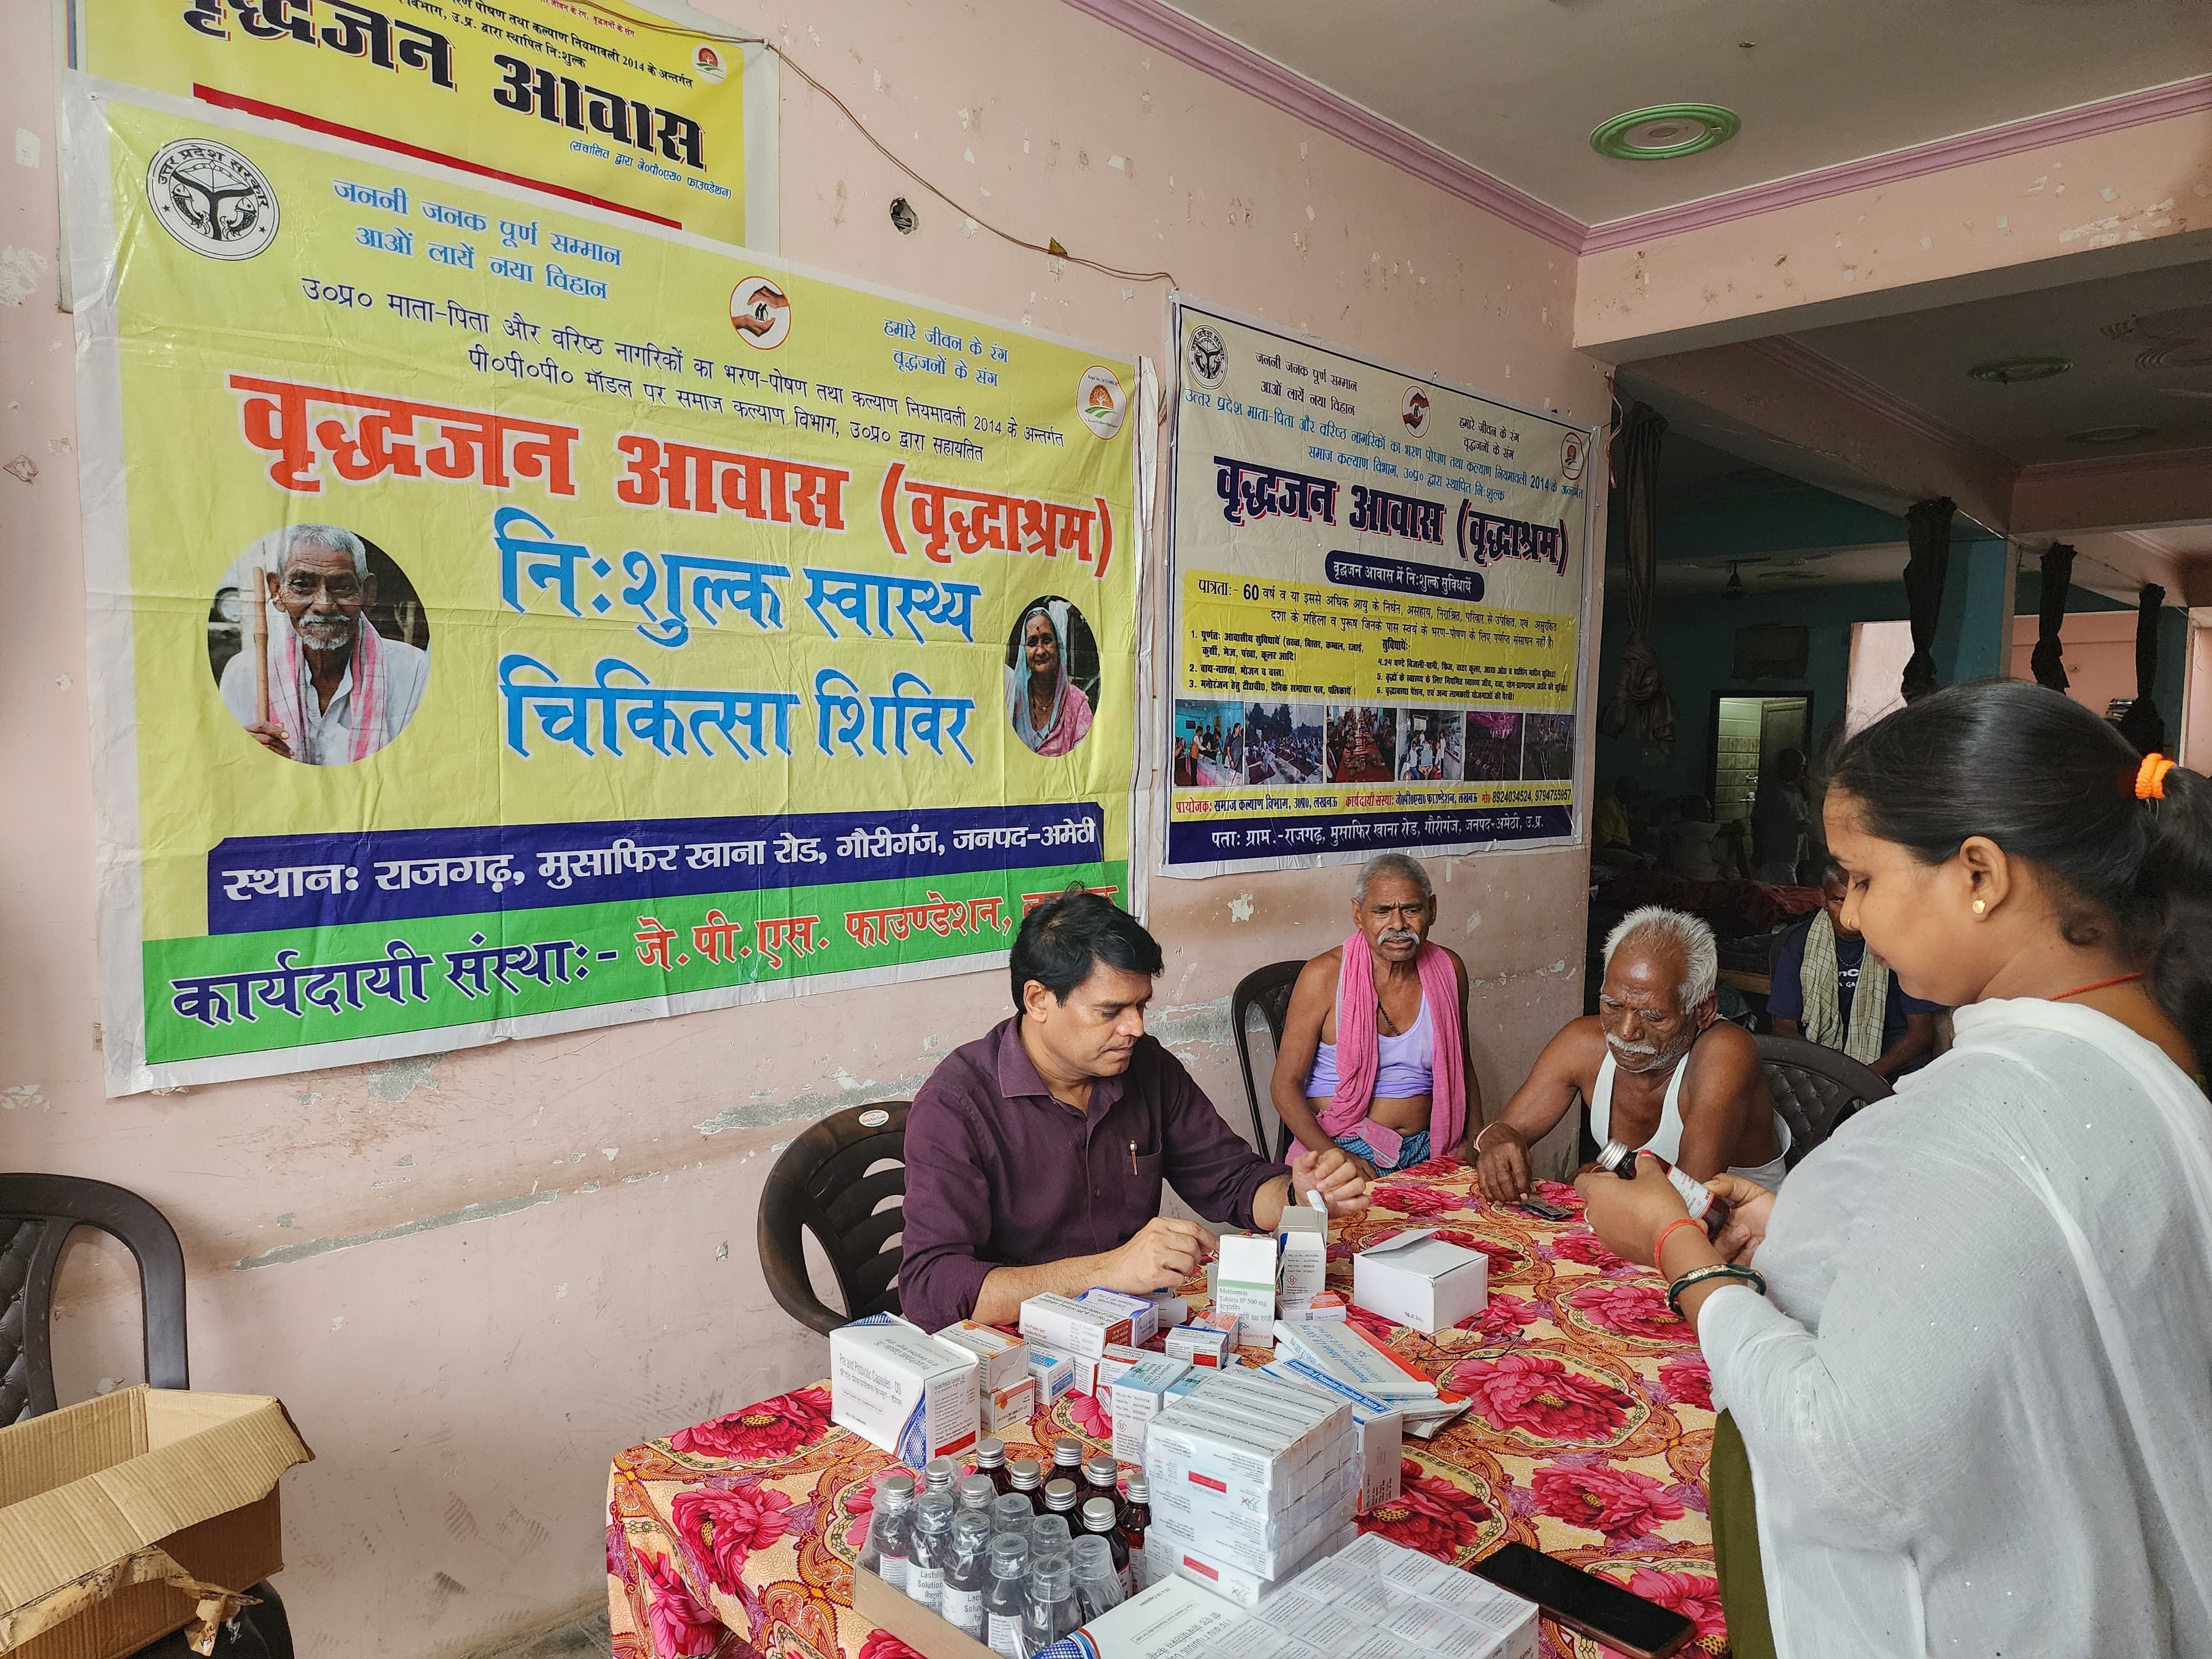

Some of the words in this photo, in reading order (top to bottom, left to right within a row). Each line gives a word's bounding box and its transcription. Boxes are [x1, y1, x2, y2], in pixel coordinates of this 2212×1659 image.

[476, 0, 507, 22] पोषण
[509, 12, 530, 30] तथा
[533, 24, 568, 46] कल्याण
[571, 32, 620, 62] नियमावली
[622, 56, 644, 72] 2014
[648, 62, 656, 76] के
[659, 70, 693, 88] अन्तर्गत
[481, 22, 503, 39] द्वारा
[507, 31, 542, 53] स्थापित
[494, 54, 706, 173] आवास
[158, 156, 179, 184] उत्तर
[178, 145, 225, 161] प्रदेश
[231, 159, 269, 209] सरकार
[615, 153, 633, 167] द्वारा
[333, 179, 409, 215] जननी
[422, 200, 487, 231] जनक
[500, 220, 538, 248] पूर्ण
[551, 232, 622, 267] सम्मान
[356, 227, 414, 255] आओं
[428, 242, 474, 269] लायें
[489, 256, 533, 283] नया
[546, 264, 608, 299] विहान
[388, 293, 490, 335] माता-पिता
[503, 312, 541, 346] और
[552, 326, 603, 356] वरिष्ठ
[615, 340, 682, 373] नागरिकों
[693, 358, 714, 379] का
[724, 364, 807, 398] भरण-पोषण
[816, 383, 843, 404] तथा
[852, 390, 898, 415] कल्याण
[906, 397, 966, 428] नियमावली
[974, 416, 1001, 435] 2014
[1008, 416, 1018, 438] के
[1024, 426, 1065, 447] अन्तर्गत
[884, 319, 916, 341] हमारे
[924, 326, 963, 351] जीवन
[969, 336, 982, 355] के
[989, 343, 1008, 363] रंग
[893, 349, 947, 375] वृद्धजनों
[954, 359, 968, 379] के
[975, 367, 998, 387] संग
[1255, 352, 1281, 370] जननी
[1285, 361, 1308, 377] जनक
[1312, 369, 1326, 385] पूर्ण
[1331, 374, 1357, 392] सम्मान
[586, 368, 633, 399] मॉडल
[644, 382, 666, 406] पर
[676, 389, 723, 414] समाज
[732, 399, 785, 426] कल्याण
[795, 406, 839, 439] विभाग,
[899, 430, 925, 451] द्वारा
[933, 436, 983, 462] सहायतित
[1261, 380, 1282, 396] आओं
[1287, 387, 1304, 403] लायें
[1310, 394, 1326, 408] नया
[1331, 396, 1355, 415] विहान
[226, 374, 580, 493] वृद्धजन
[616, 433, 848, 533] आवास
[881, 462, 1110, 578] (वृद्धाश्रम)
[1185, 388, 1211, 407] उत्तर
[1217, 394, 1243, 415] प्रदेश
[1247, 405, 1294, 428] माता-पिता
[1300, 416, 1314, 432] और
[1320, 421, 1347, 440] वरिष्ठ
[1351, 430, 1385, 450] नागरिकों
[1390, 440, 1401, 454] का
[1405, 442, 1421, 459] भरण
[1426, 446, 1446, 465] पोषण
[1450, 456, 1463, 469] तथा
[1467, 460, 1491, 477] कल्याण
[1495, 466, 1527, 486] नियमावली
[1531, 476, 1549, 491] 2014
[1551, 479, 1557, 492] के
[1562, 484, 1583, 499] अन्तर्गत
[1214, 456, 1339, 526] वृद्धजन
[1349, 485, 1446, 545] आवास
[1457, 498, 1568, 576] (वृद्धाश्रम)
[801, 564, 984, 644] स्वास्थ्य
[1244, 584, 1259, 601] 60
[1262, 585, 1276, 601] वर्ष
[1279, 590, 1286, 601] व
[1291, 591, 1300, 603] या
[1304, 591, 1321, 606] इससे
[1326, 595, 1349, 608] अधिक
[1353, 598, 1368, 613] आयु
[1372, 598, 1379, 611] के
[1383, 599, 1403, 616] निर्धन,
[1407, 605, 1433, 620] असहाय,
[1465, 611, 1484, 624] परिवार
[1487, 613, 1493, 625] से
[1495, 613, 1516, 629] उपेक्षित,
[1520, 616, 1529, 629] एवं
[1333, 561, 1361, 580] वृद्धजन
[1365, 565, 1394, 582] आवास
[1396, 566, 1405, 581] में
[1442, 575, 1472, 595] सुविधायें
[499, 654, 800, 759] चिकित्सा
[815, 670, 976, 764] शिविर
[1214, 799, 1237, 812] समाज
[1239, 799, 1264, 811] कल्याण
[1266, 793, 1291, 811] विभाग,
[1314, 796, 1338, 808] लखनऊ
[1331, 820, 1371, 846] मुसाफिर
[1374, 822, 1400, 839] खाना
[1401, 815, 1420, 838] रोड,
[1425, 814, 1462, 837] गौरीगंज,
[1345, 791, 1374, 807] कार्यदायी
[1427, 790, 1457, 805] फाउण्डेशन,
[1458, 792, 1478, 803] लखनऊ
[1535, 789, 1572, 802] 9794755957
[374, 852, 523, 895] राजगढ़,
[538, 837, 678, 889] मुसाफिर
[685, 837, 764, 872] खाना
[773, 831, 827, 869] रोड,
[837, 824, 945, 859] गौरीगंज,
[953, 816, 1096, 851] जनपद-अमेठी
[170, 938, 432, 1029] कार्यदायी
[844, 890, 1011, 948] फाउण्डेशन,
[1231, 1434, 1275, 1452] Betamethasone
